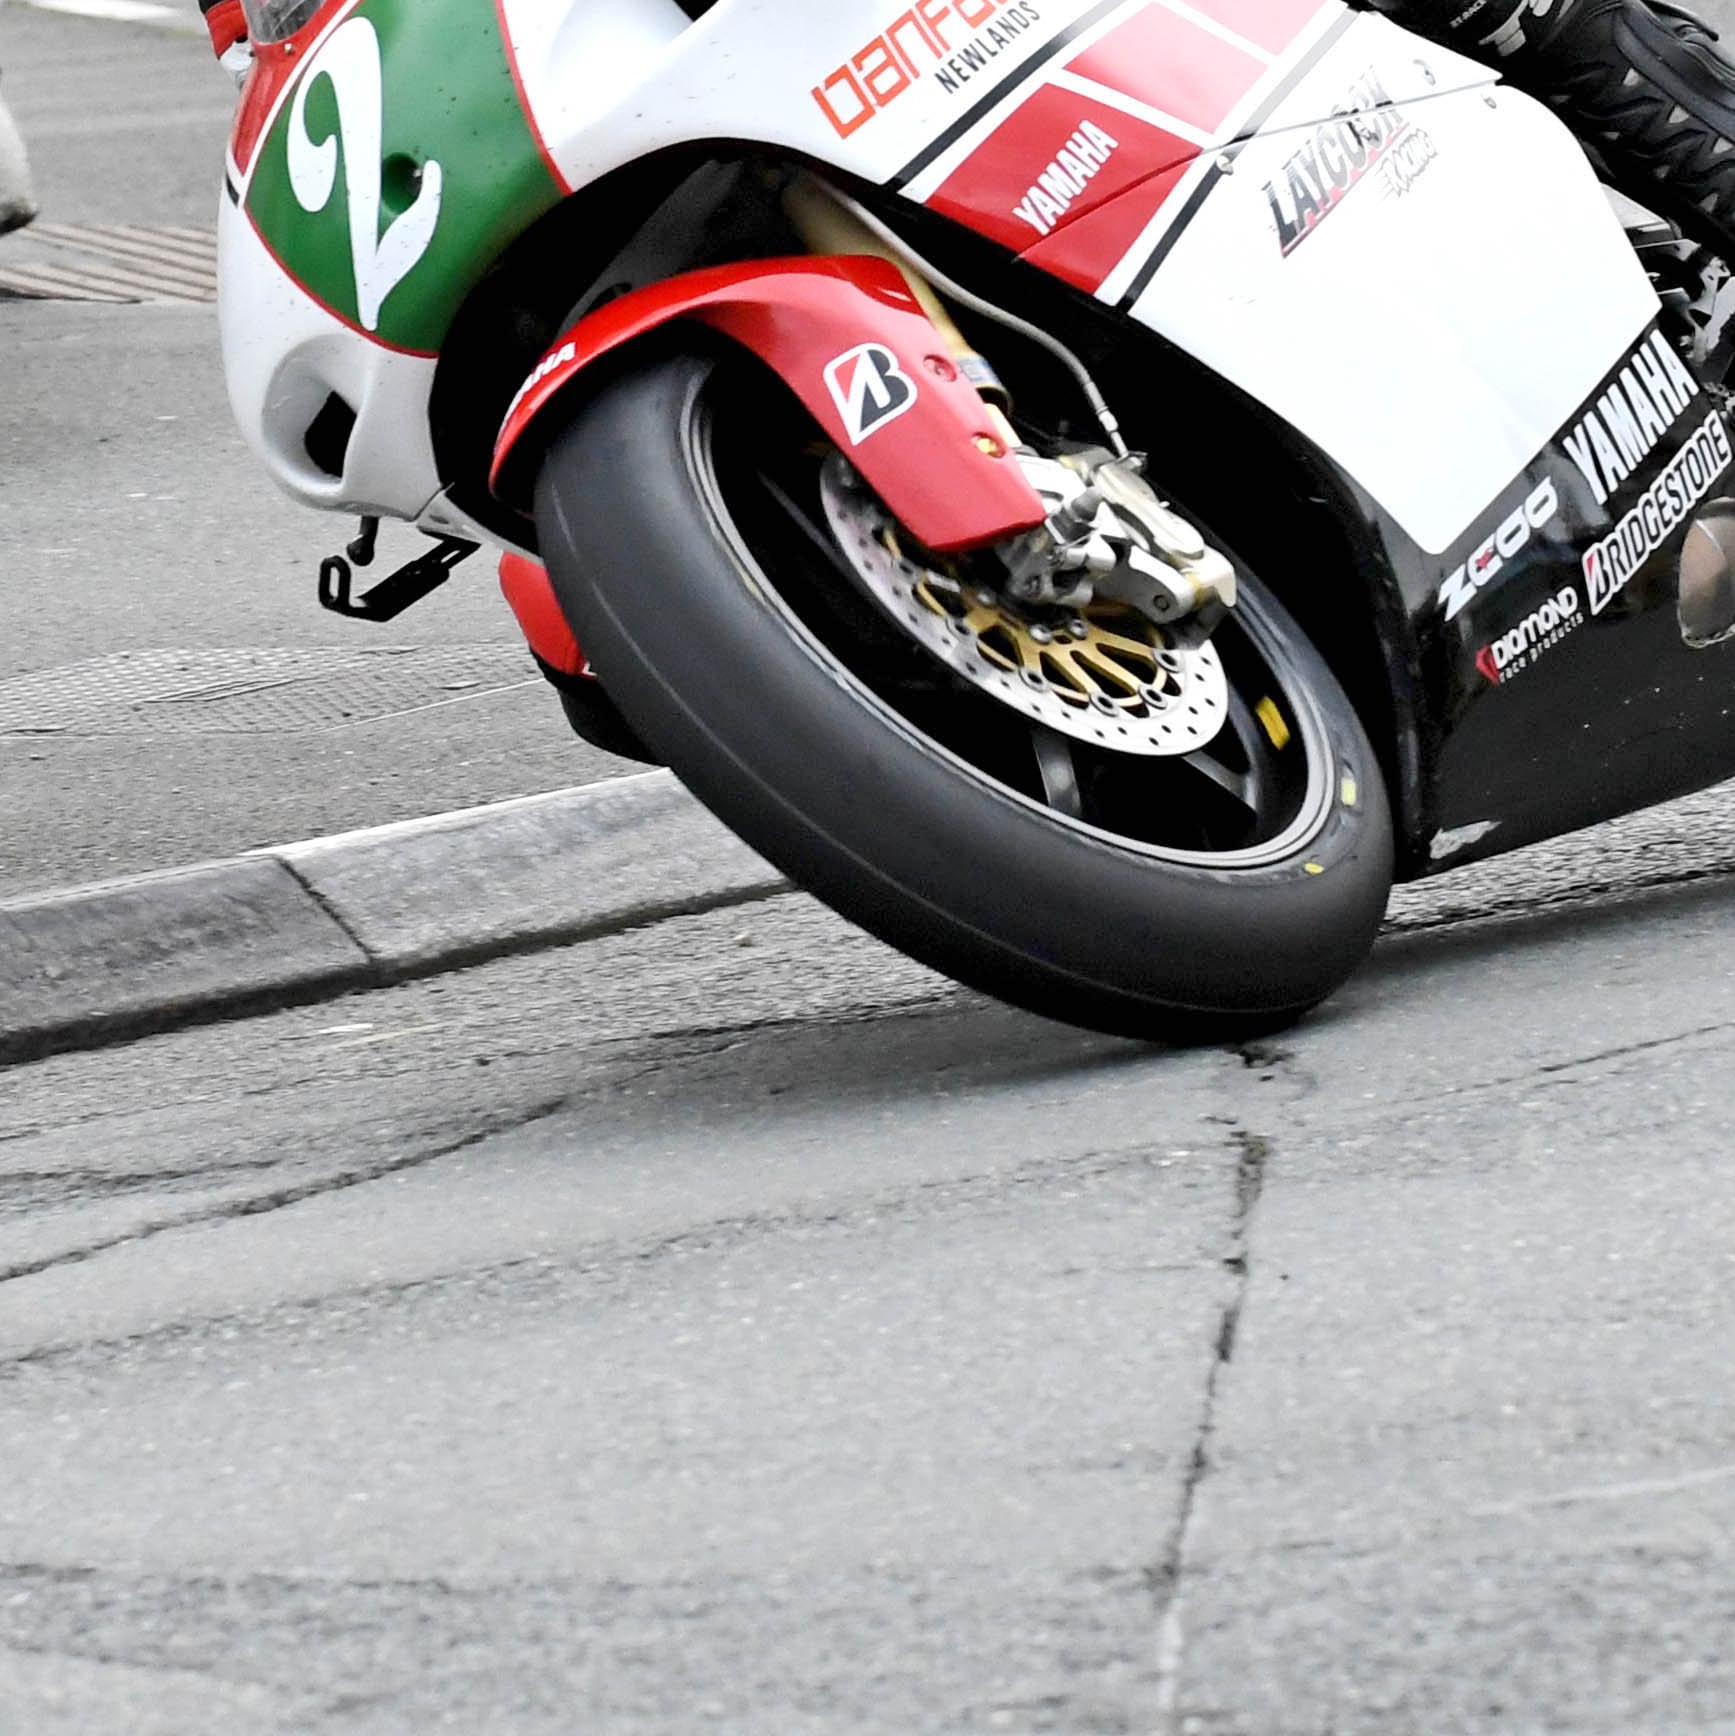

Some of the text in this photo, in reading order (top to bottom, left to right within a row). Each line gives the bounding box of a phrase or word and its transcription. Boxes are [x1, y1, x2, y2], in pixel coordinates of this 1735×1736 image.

[934, 0, 1040, 94] NEWLANDS
[286, 16, 441, 332] 2
[1012, 119, 1119, 236] YAMAHA
[1562, 328, 1700, 505] YAMAHA
[1437, 476, 1558, 622] ZCOO
[1583, 410, 1731, 614] BRIDGESTONE
